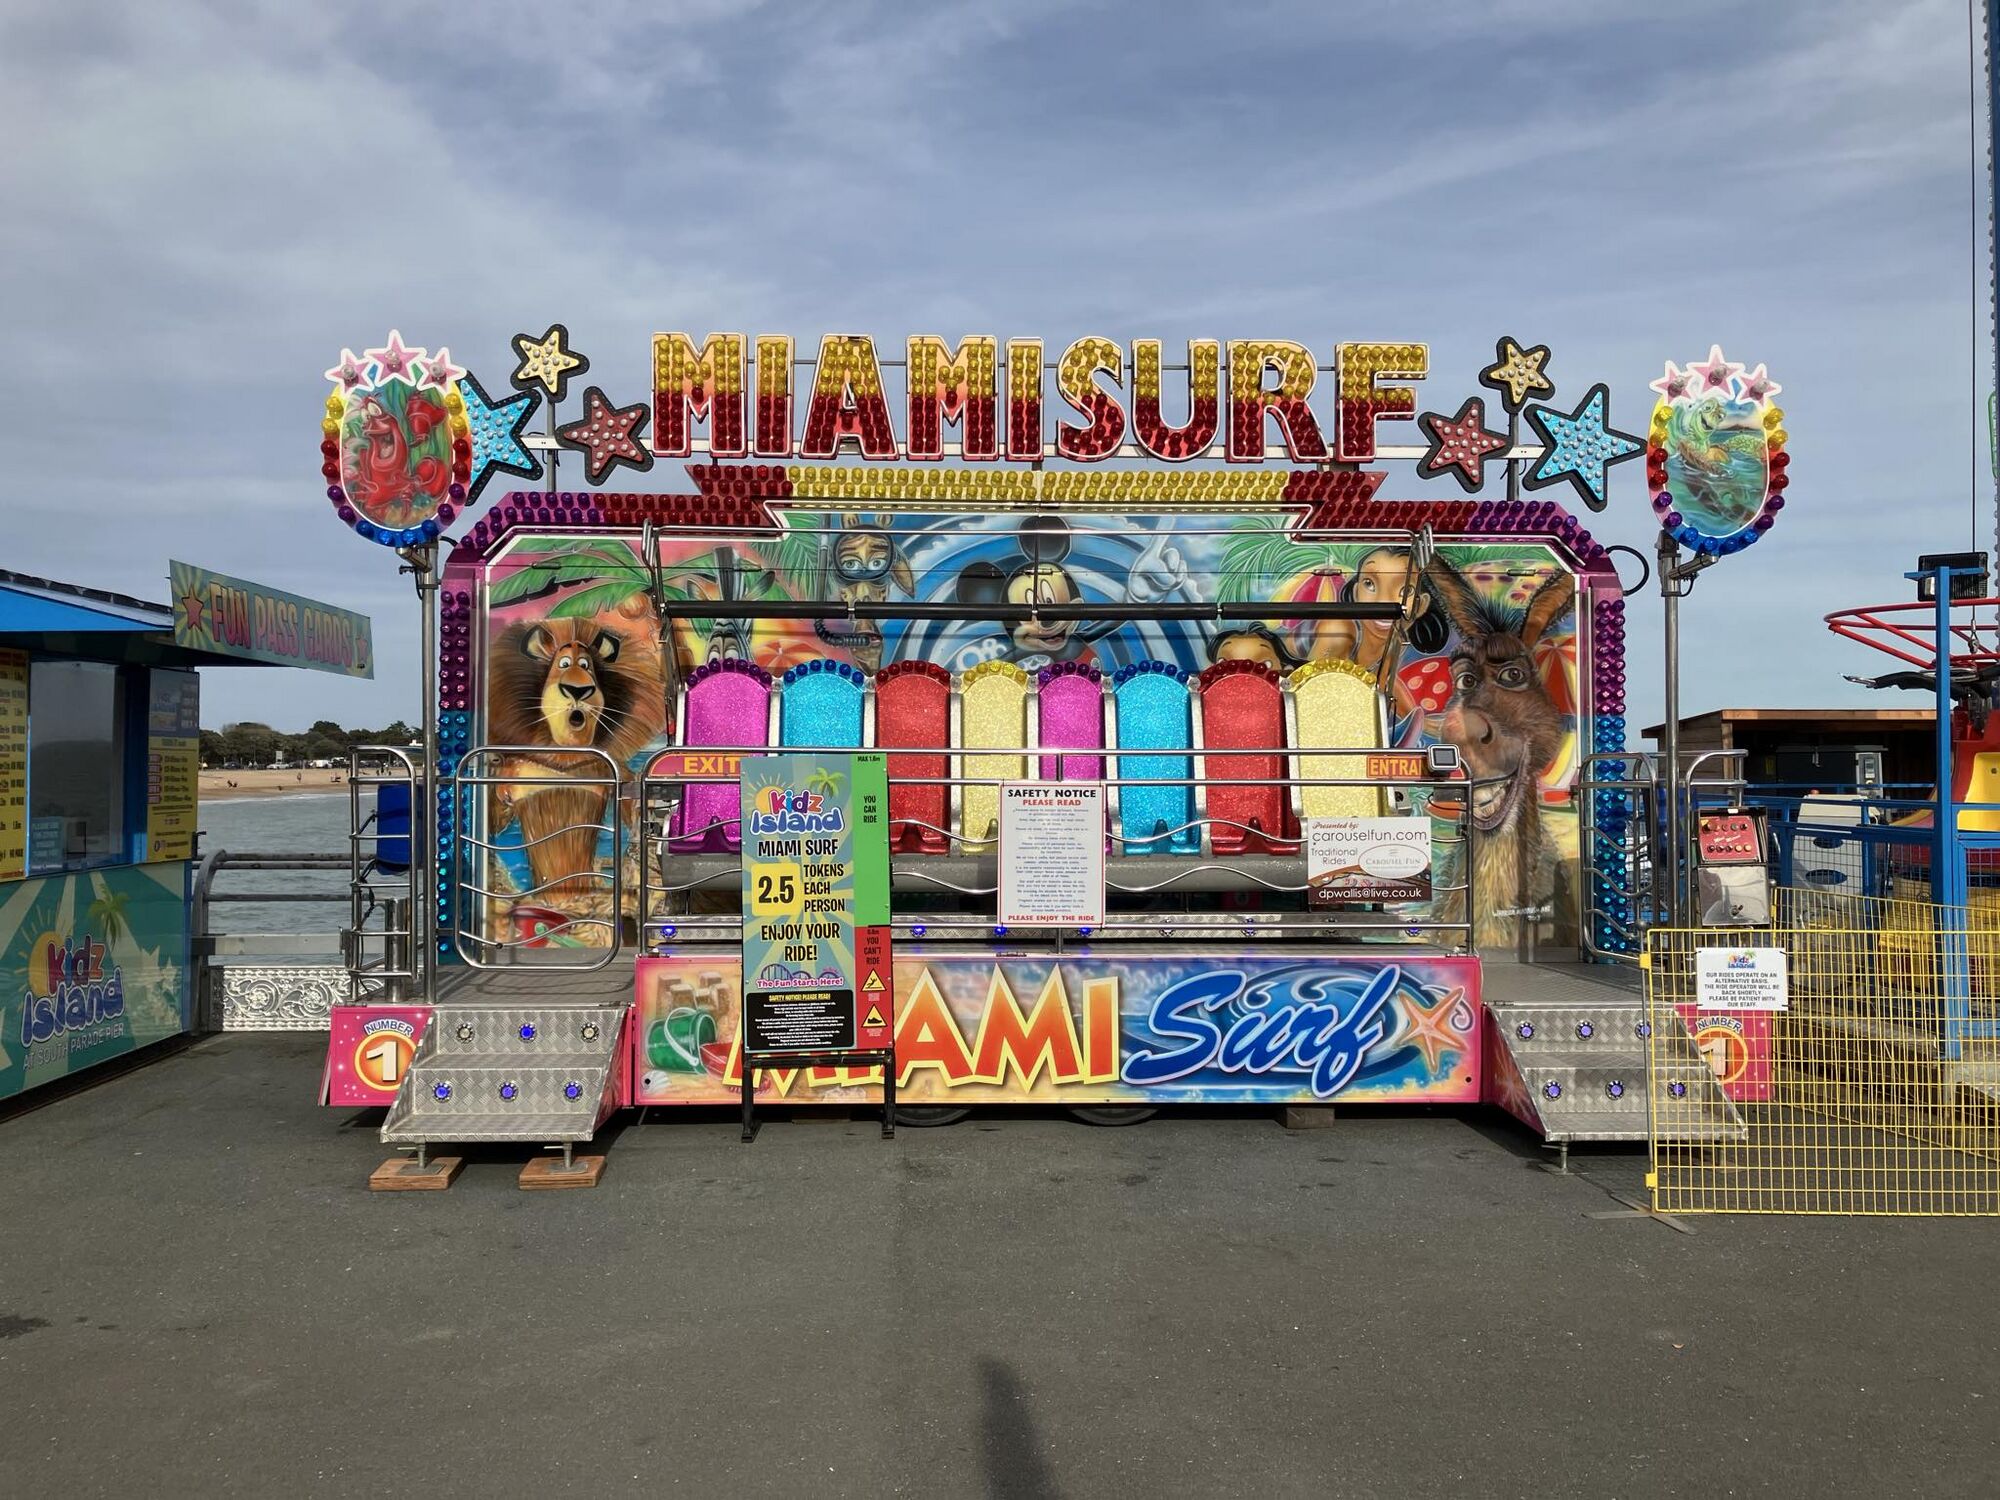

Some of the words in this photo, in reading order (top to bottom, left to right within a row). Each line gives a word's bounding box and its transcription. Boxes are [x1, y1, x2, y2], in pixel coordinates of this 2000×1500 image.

[209, 581, 251, 649] FUN
[255, 595, 299, 658] PASS
[684, 756, 740, 773] EXIT
[864, 795, 876, 803] YOU
[1008, 789, 1050, 798] SAFETY
[1055, 789, 1096, 798] NOTICE
[864, 805, 876, 813] CAN
[750, 807, 845, 835] Island
[863, 815, 877, 823] RIDE
[1312, 829, 1427, 841] carouselfun.com
[758, 840, 801, 857] MIAMI
[805, 839, 838, 855] SURF
[1311, 848, 1358, 857] Traditional
[1322, 857, 1347, 865] Rides
[804, 864, 844, 878] TOKENS
[758, 875, 795, 904] 2.5
[804, 881, 831, 895] EACH
[1318, 888, 1422, 900] dpwallis@live.co.uk
[804, 899, 845, 913] PERSON
[761, 924, 802, 941] ENJOY
[805, 923, 840, 939] YOUR
[867, 937, 879, 945] YOU
[784, 945, 818, 962] RIDE!
[864, 947, 881, 955] CAN'T
[866, 957, 880, 965] RIDE
[756, 980, 773, 988] The
[775, 980, 791, 988] Fun
[793, 979, 818, 987] Starts
[820, 978, 844, 986] Here!
[21, 966, 125, 1048] Island
[365, 1019, 413, 1037] NUMBER
[1120, 963, 1401, 1098] Surf
[1697, 1016, 1742, 1033] NUMBER
[39, 1043, 68, 1065] SOUTH
[70, 1030, 104, 1053] PARADE
[105, 1022, 124, 1040] PIER
[366, 1041, 397, 1082] 1
[1700, 1037, 1726, 1076] 1
